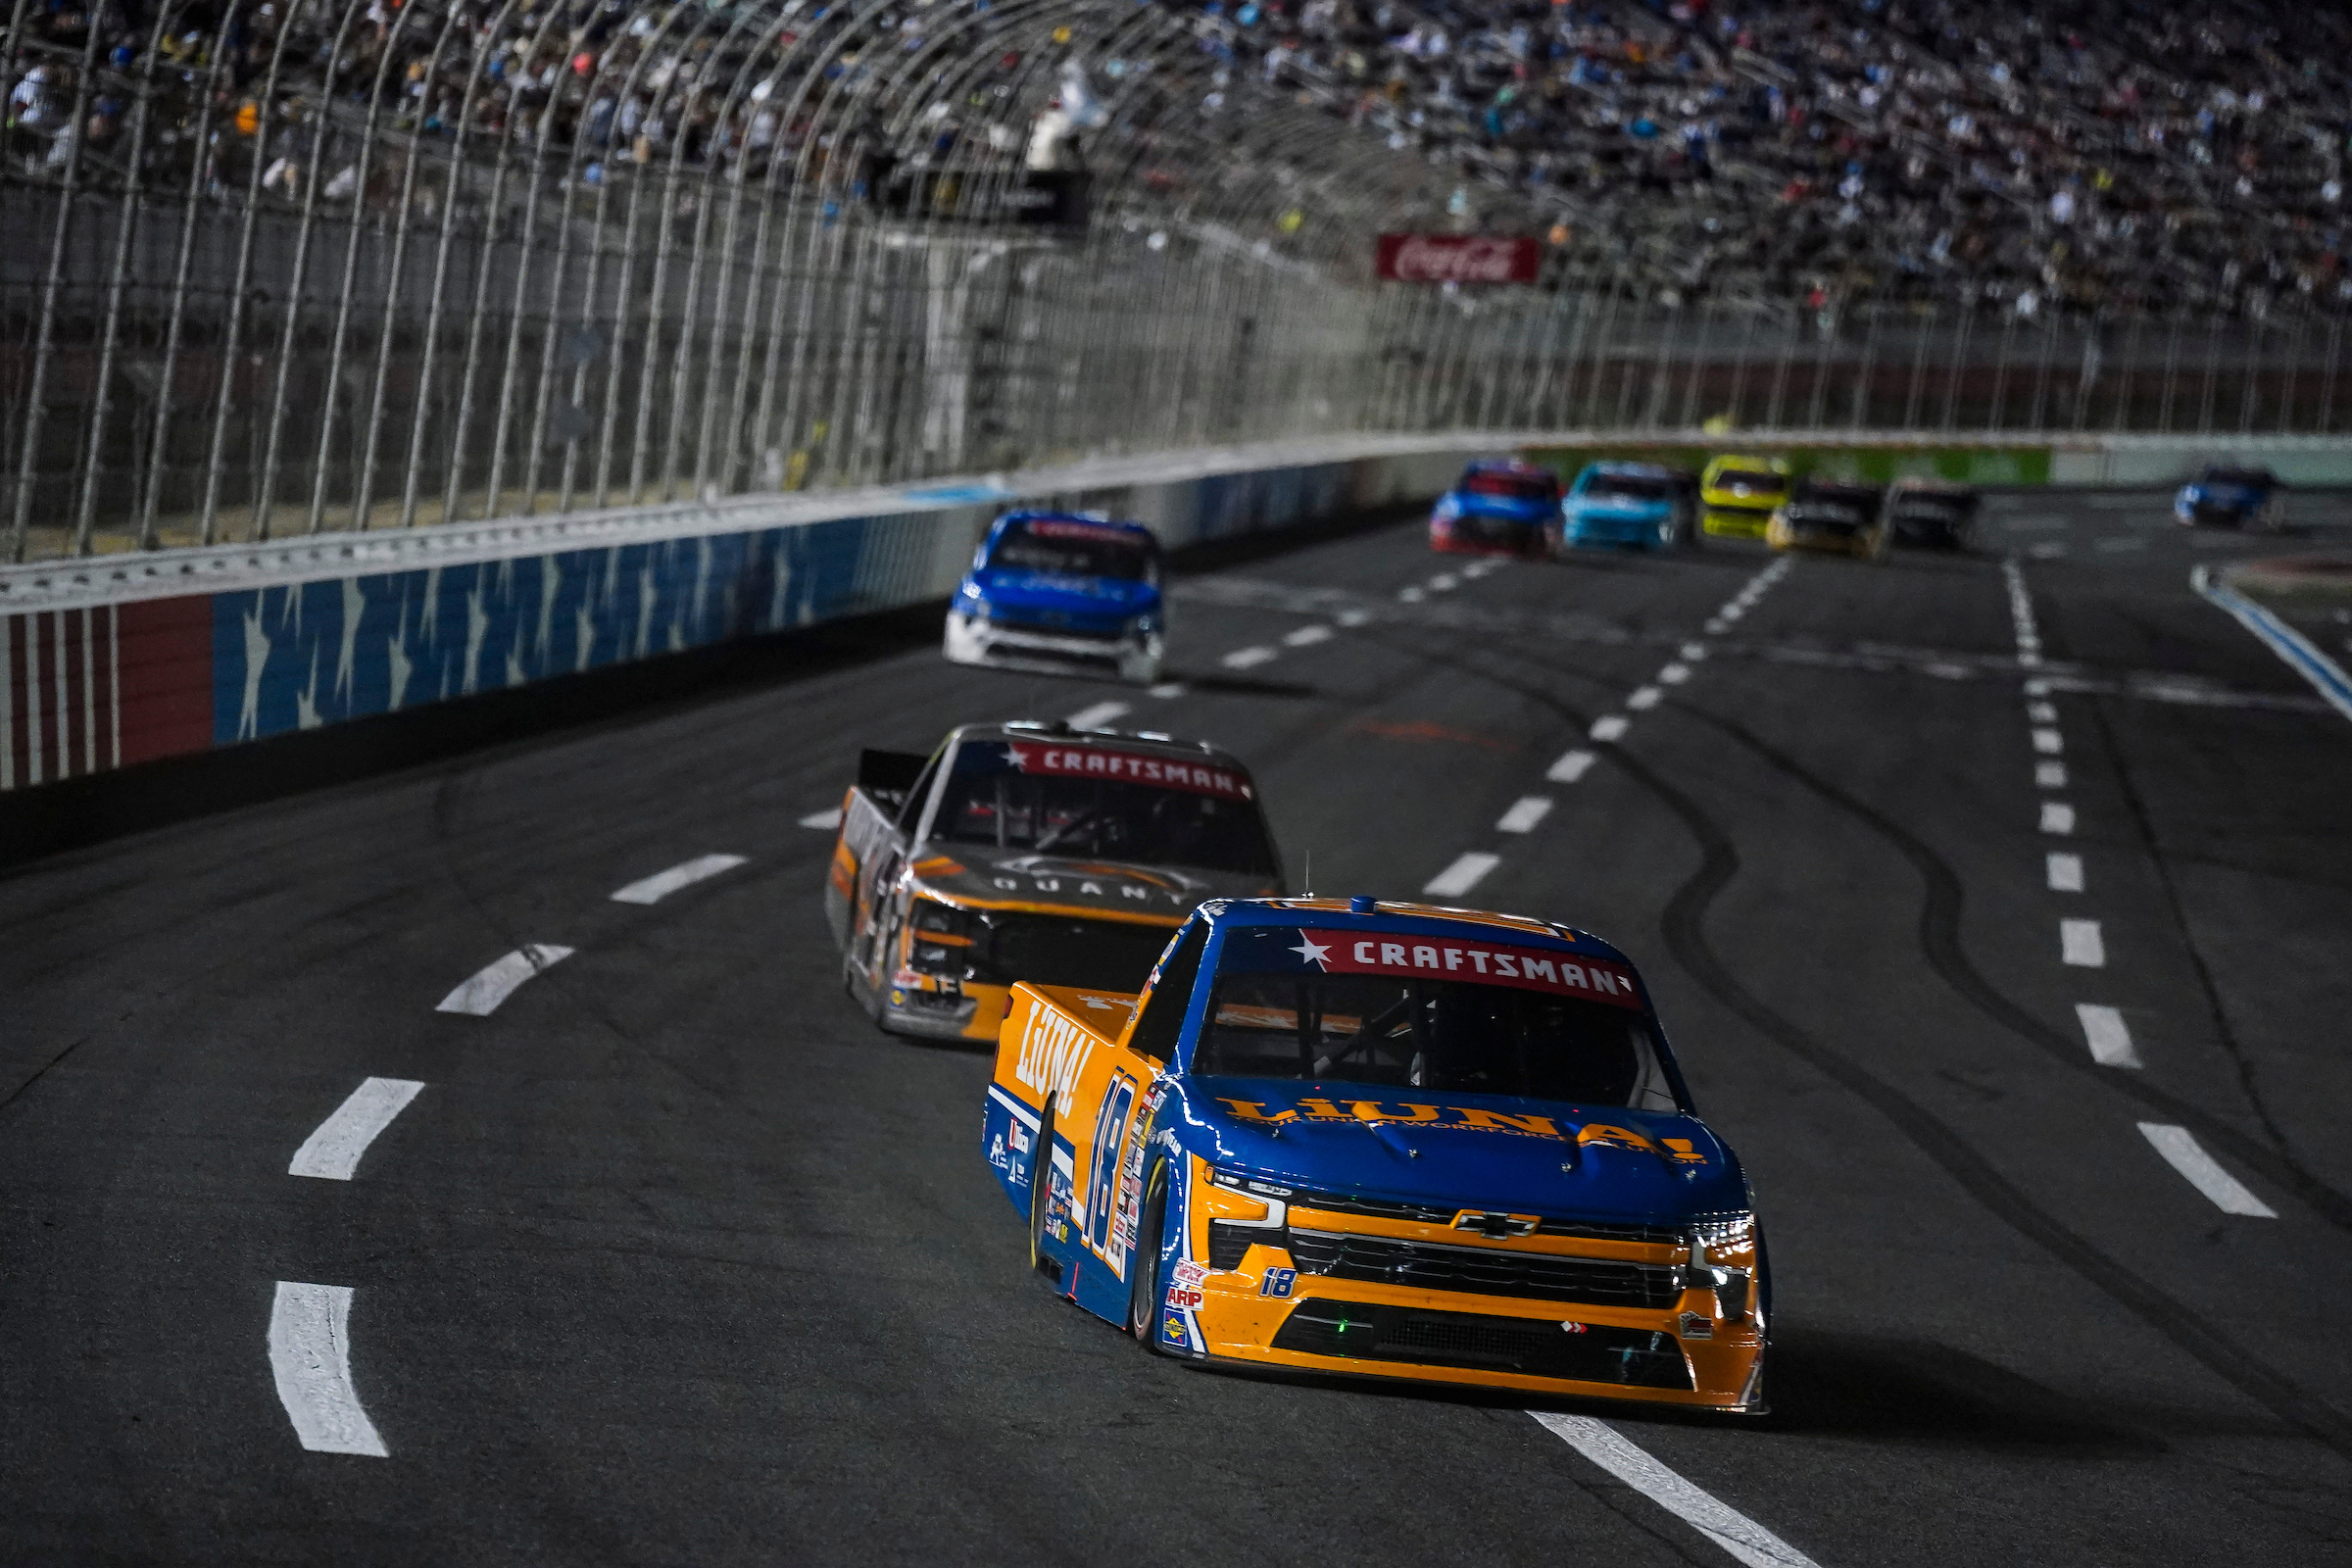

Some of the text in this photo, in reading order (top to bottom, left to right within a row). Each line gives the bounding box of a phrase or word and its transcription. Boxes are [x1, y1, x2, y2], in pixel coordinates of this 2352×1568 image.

[1043, 750, 1235, 793] CRAFTSMAN
[993, 878, 1188, 906] QUANT
[1353, 941, 1620, 996] CRAFTSMAN
[1215, 1097, 1705, 1159] LiUNA!
[1308, 1115, 1396, 1126] UNIN
[1080, 1065, 1139, 1262] 18
[1167, 1288, 1202, 1307] ARP
[1259, 1267, 1298, 1298] 18
